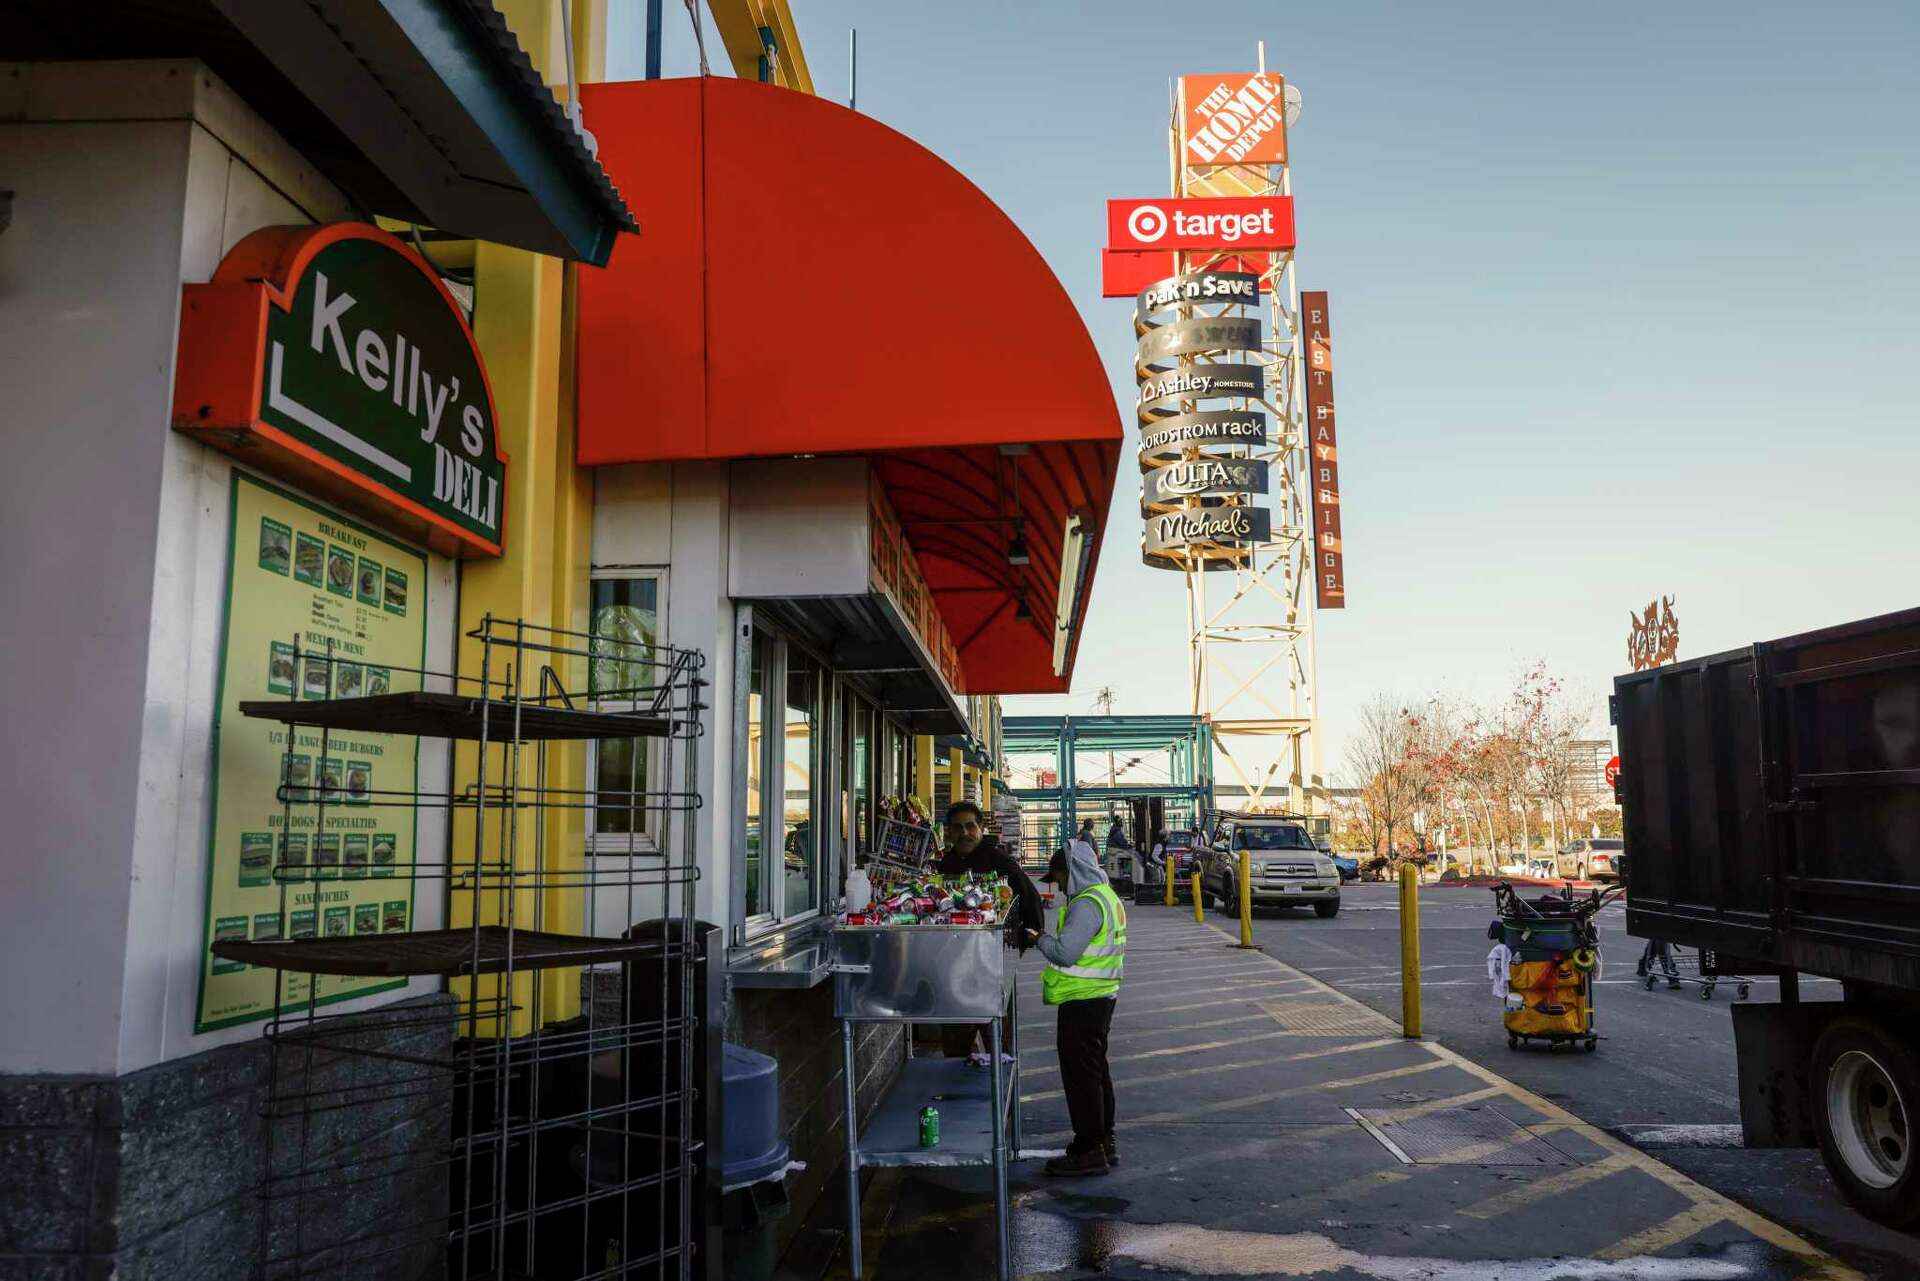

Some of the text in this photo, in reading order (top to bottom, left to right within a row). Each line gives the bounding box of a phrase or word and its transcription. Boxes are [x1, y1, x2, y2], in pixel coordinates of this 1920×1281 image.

[1194, 82, 1234, 118] THE
[1187, 72, 1281, 162] HOME
[1225, 104, 1282, 162] DEPOT
[1172, 208, 1274, 241] target
[310, 271, 484, 457] Kelly's
[1311, 310, 1327, 385] EAST
[1156, 372, 1212, 398] Ashley
[1139, 419, 1262, 451] NORDSTROM rack
[432, 442, 499, 530] DELI
[1170, 462, 1228, 485] ULTA
[318, 521, 368, 552] BREAKFAST
[1155, 509, 1249, 542] Michaels
[350, 741, 384, 756] BURGERS
[291, 815, 315, 827] DOGS
[326, 816, 377, 829] SPECIALTIES
